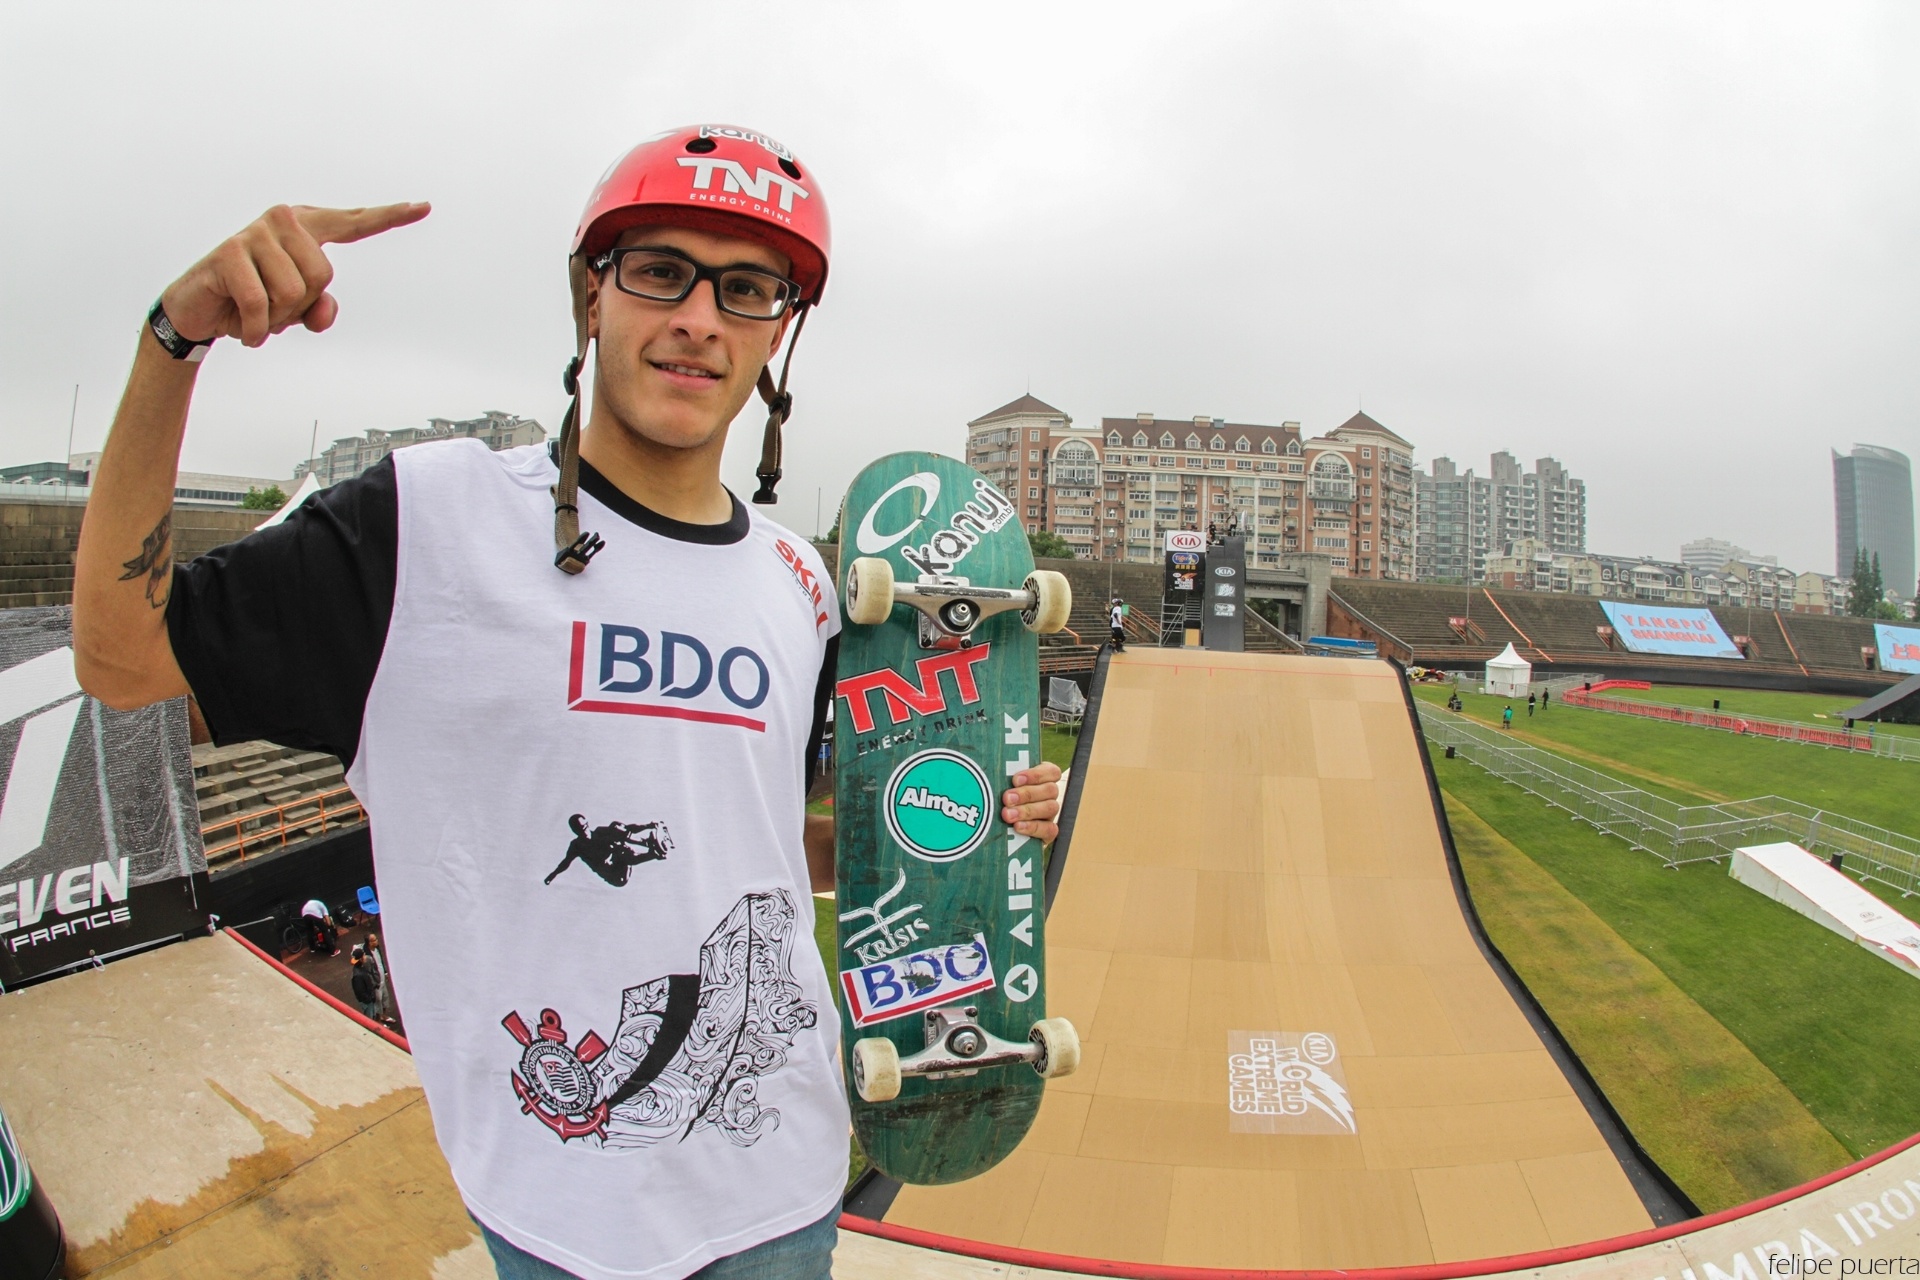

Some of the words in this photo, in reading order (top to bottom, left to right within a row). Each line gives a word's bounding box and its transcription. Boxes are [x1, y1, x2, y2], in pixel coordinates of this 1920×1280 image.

[676, 156, 810, 214] TNT
[689, 192, 747, 207] ENERGY
[753, 203, 792, 225] DRINK
[902, 478, 1011, 576] kanui
[1175, 536, 1197, 547] KIA
[1217, 566, 1233, 576] KIA
[1621, 614, 1707, 632] YANGPU
[1631, 628, 1717, 645] SHANGHAI
[599, 622, 770, 710] BDO
[836, 642, 991, 735] TNT
[898, 786, 981, 828] Almost
[11, 906, 131, 953] FRANCE
[853, 917, 931, 967] KRISIS
[861, 940, 989, 1009] BDO
[1307, 1036, 1329, 1059] KIA
[1229, 1054, 1257, 1114] GAMES
[1251, 1040, 1281, 1113] EXTREME
[1275, 1048, 1311, 1114] WORLD
